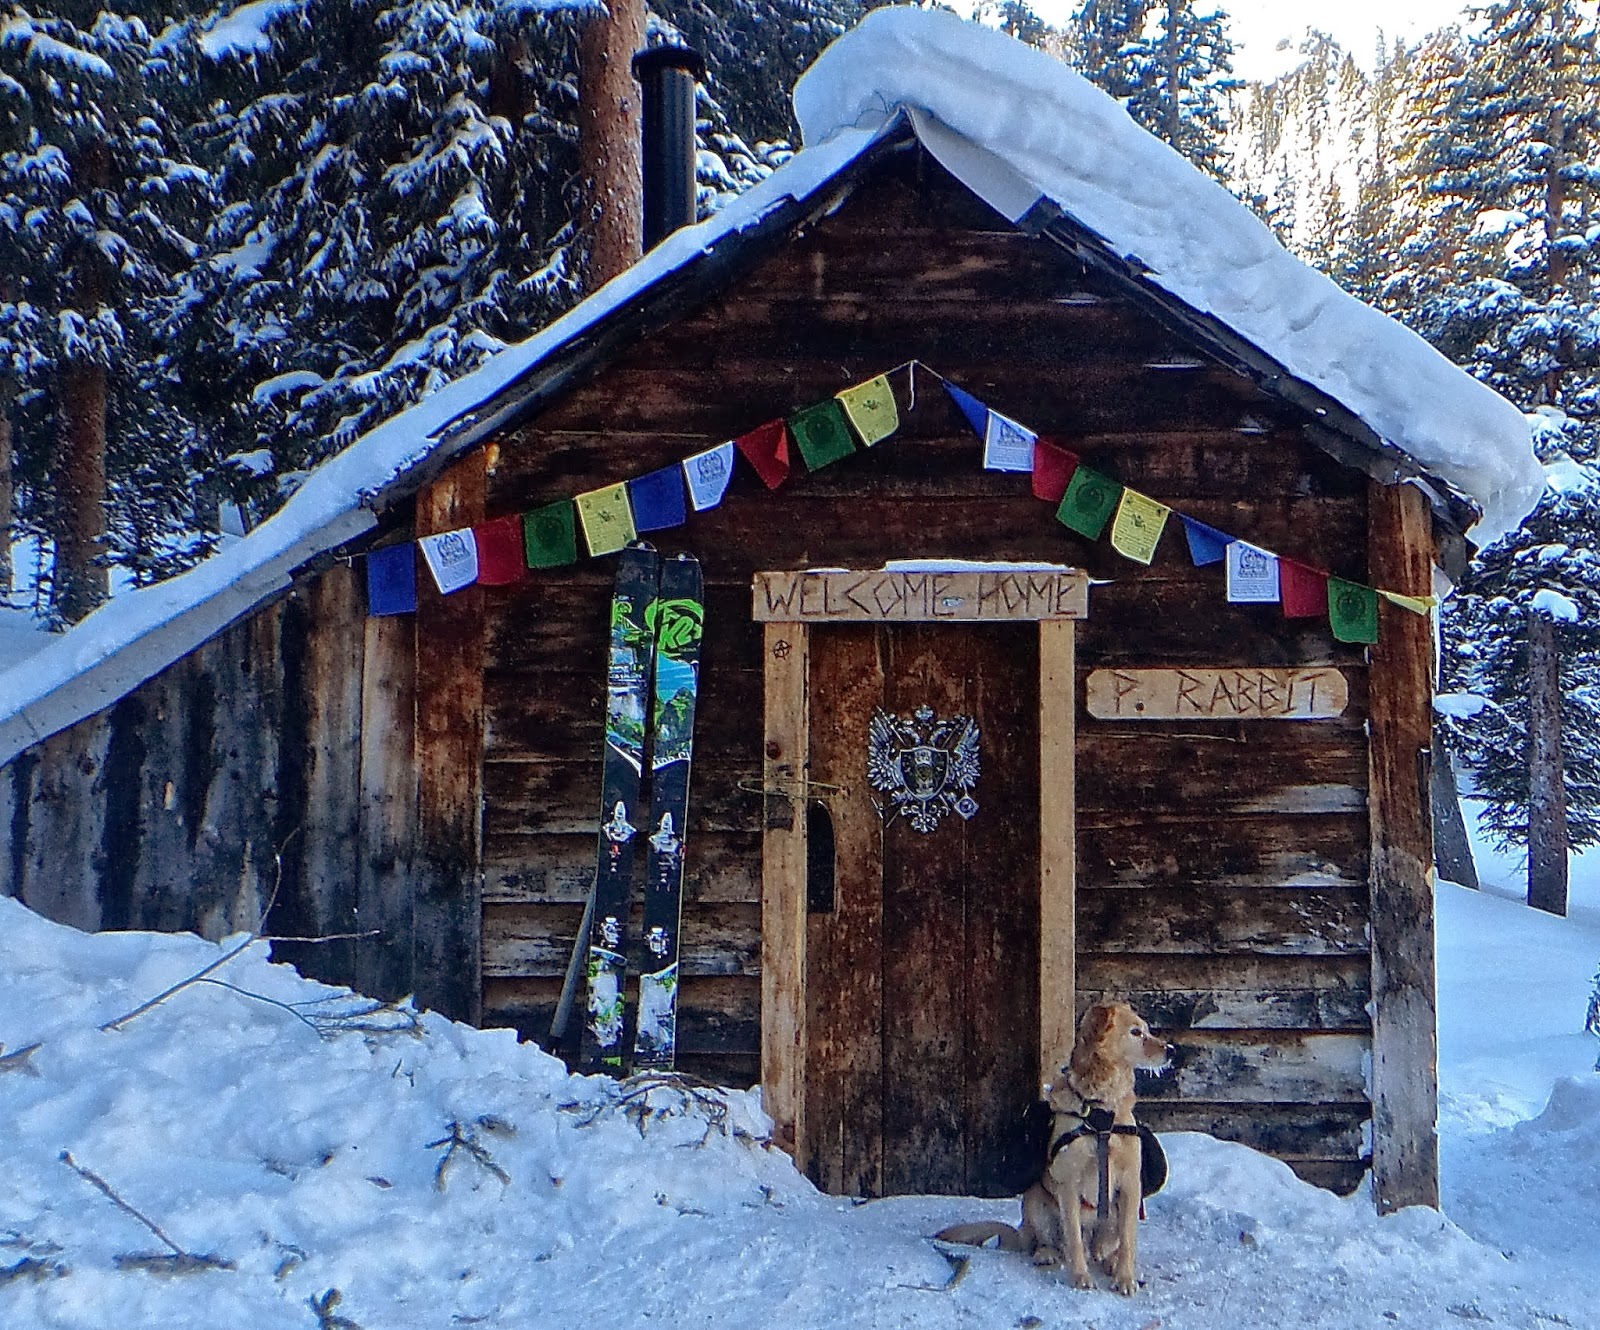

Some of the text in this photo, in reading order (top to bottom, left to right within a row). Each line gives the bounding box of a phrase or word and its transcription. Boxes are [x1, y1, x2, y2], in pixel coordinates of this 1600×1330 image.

[762, 572, 1079, 618] WELCOME HOME
[657, 615, 694, 650] K2
[1110, 669, 1327, 714] P. RABBIT
